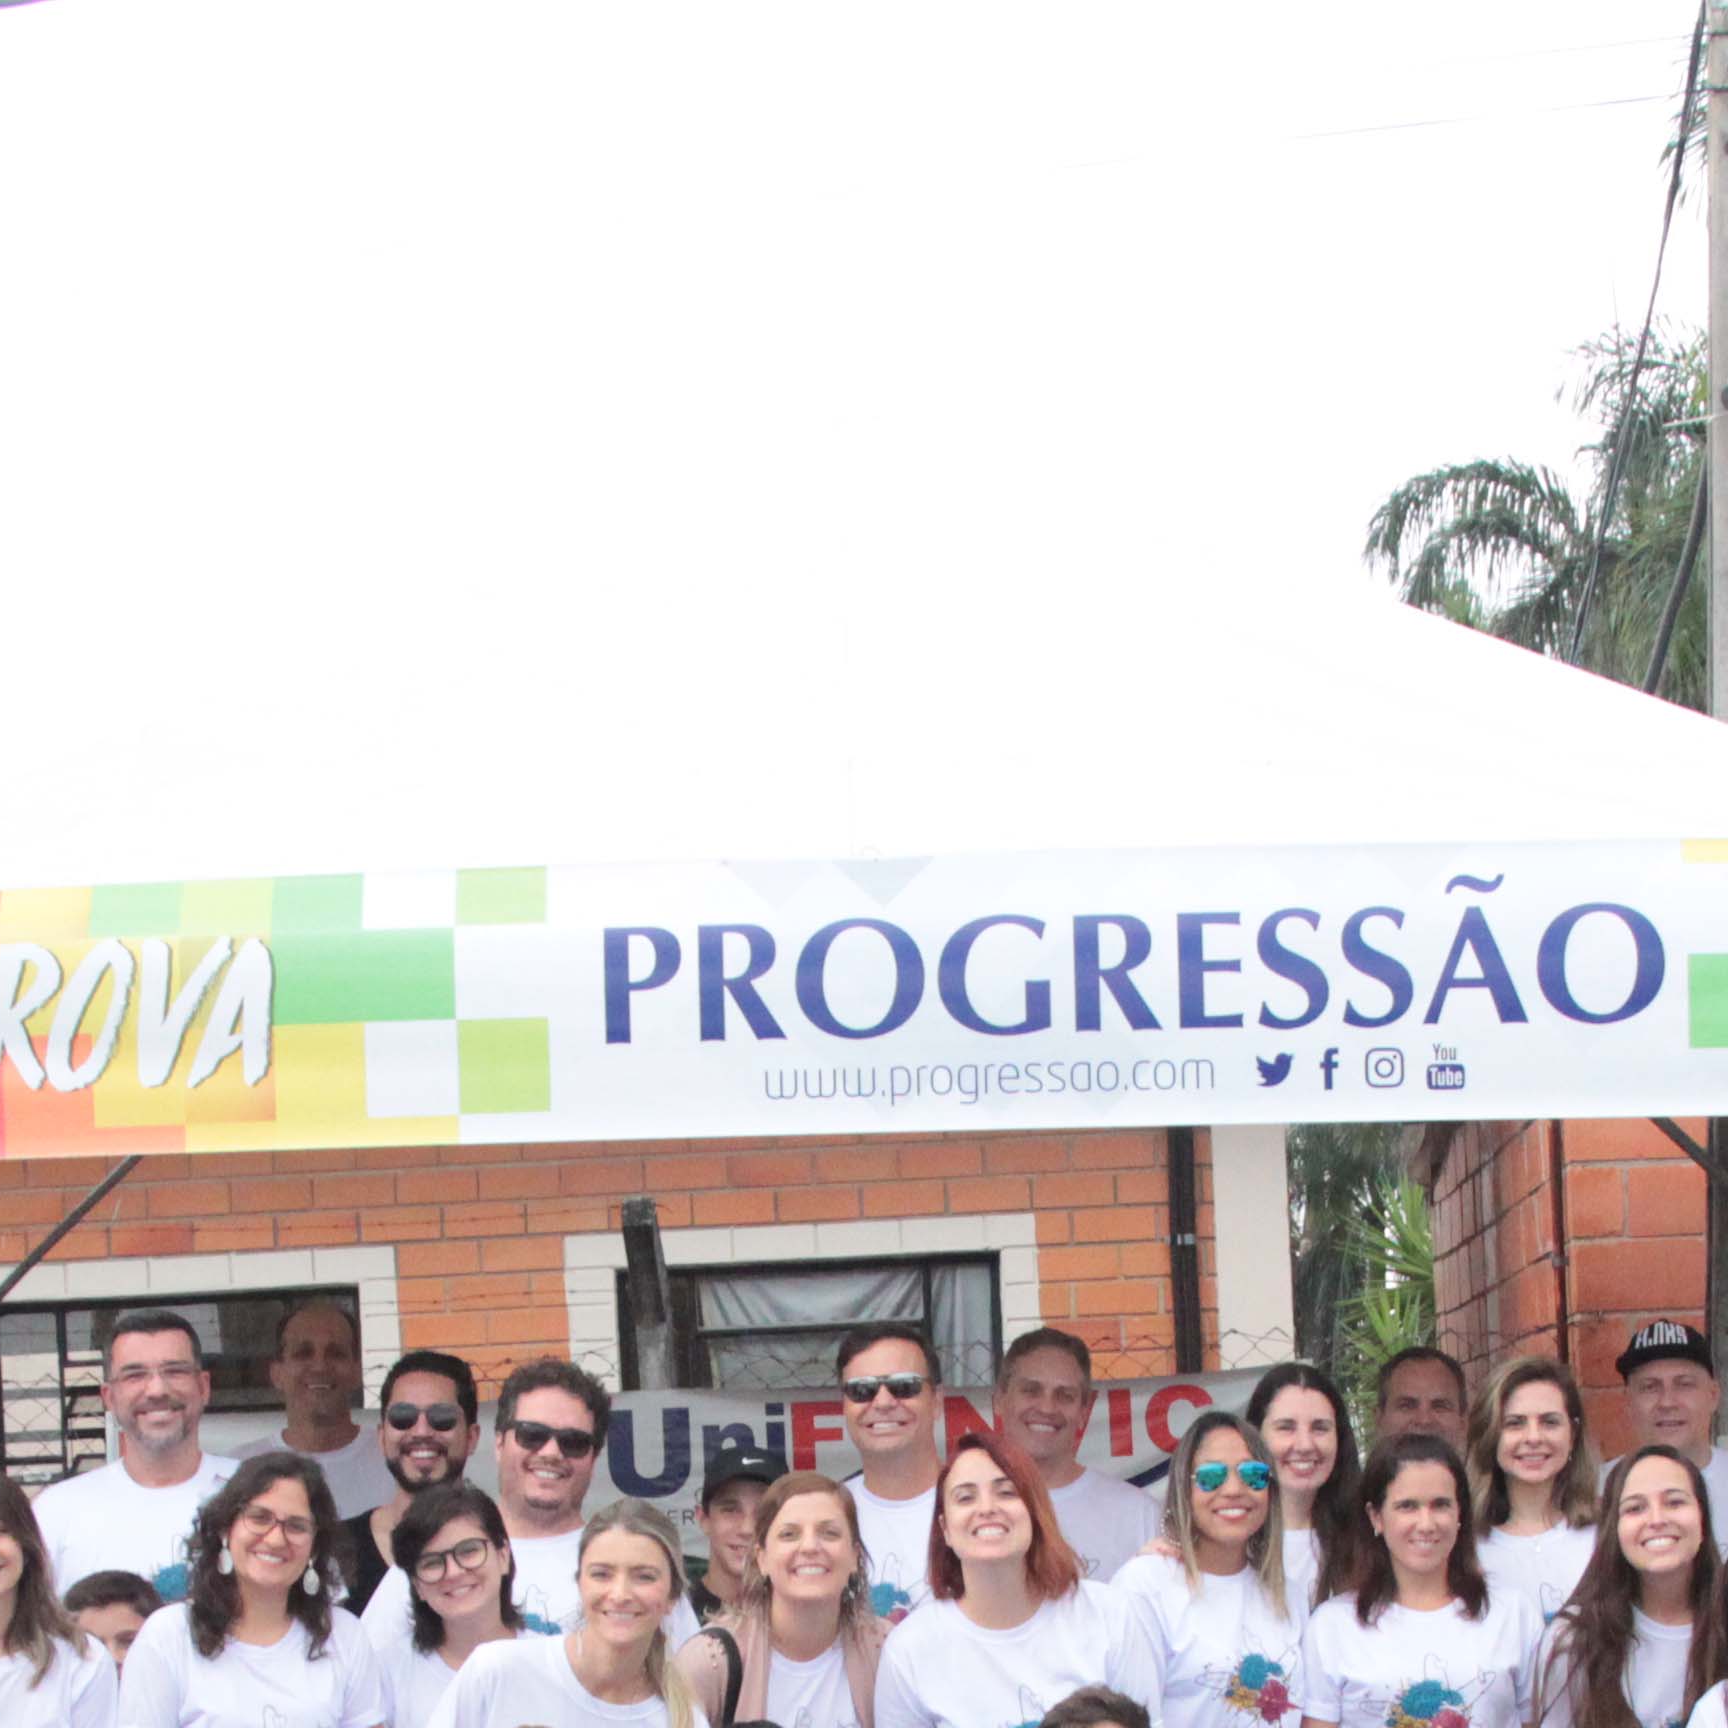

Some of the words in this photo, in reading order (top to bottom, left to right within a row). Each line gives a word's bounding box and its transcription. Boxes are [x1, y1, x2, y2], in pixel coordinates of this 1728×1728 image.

[603, 873, 1665, 1044] PROGRESSÃO
[1432, 1043, 1457, 1061] You
[764, 1057, 1215, 1106] www.progressao.com
[1430, 1066, 1463, 1087] Tube
